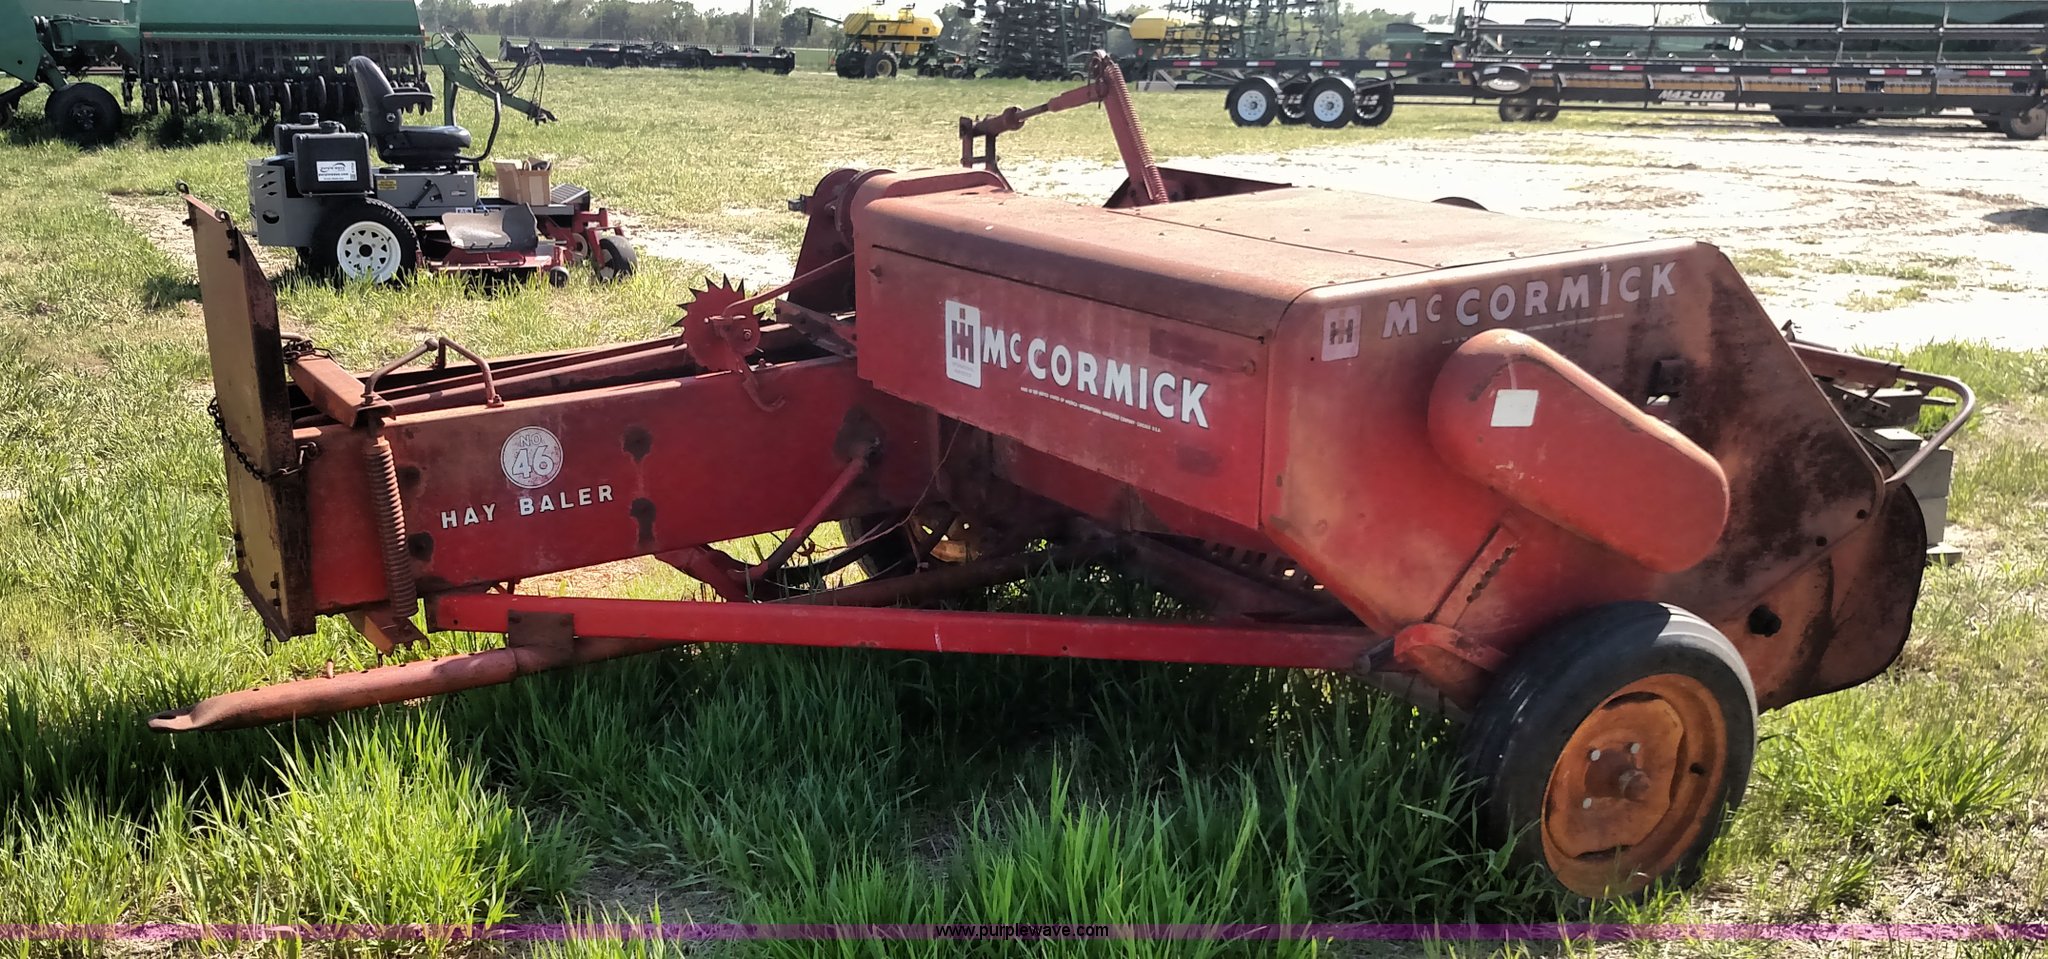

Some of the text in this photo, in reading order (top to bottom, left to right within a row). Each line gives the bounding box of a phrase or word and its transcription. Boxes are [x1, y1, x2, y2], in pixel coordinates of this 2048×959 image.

[511, 445, 554, 479] 46
[440, 484, 613, 529] HAY BALER
